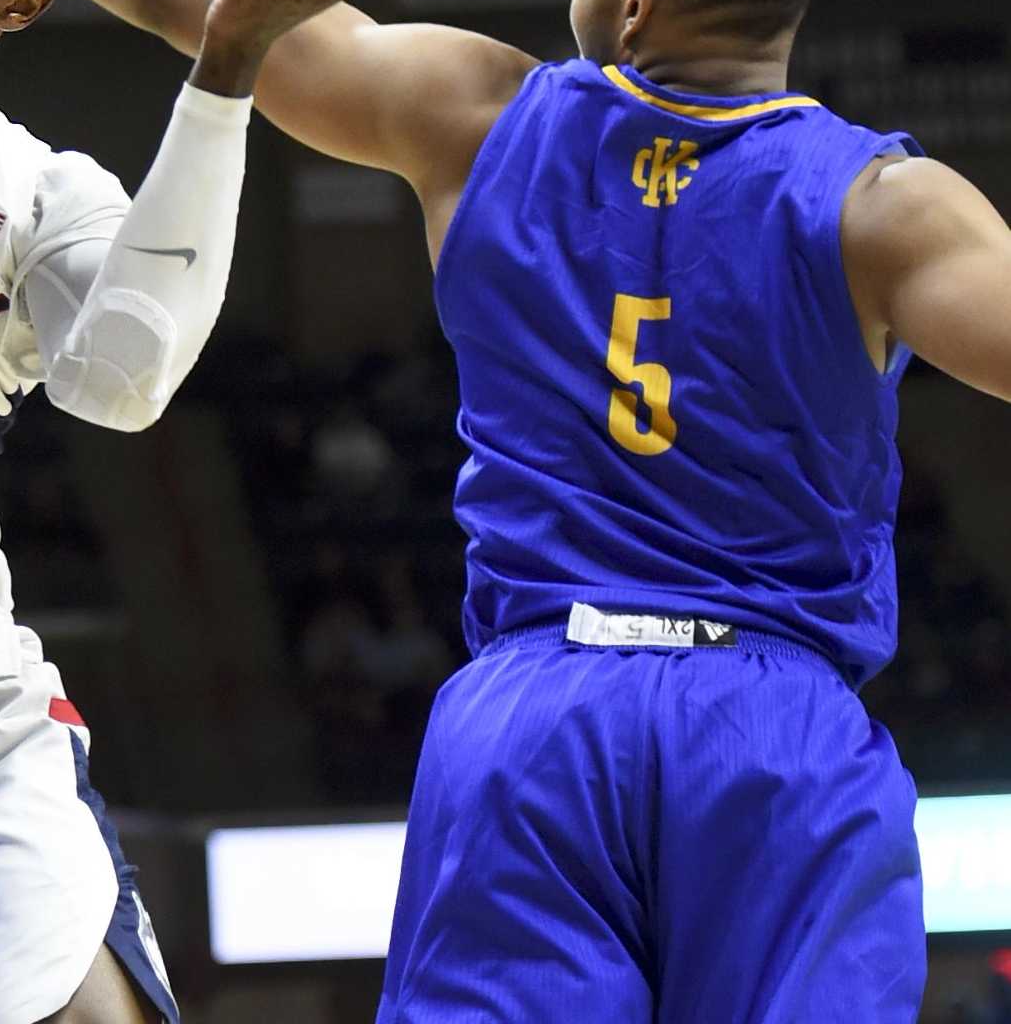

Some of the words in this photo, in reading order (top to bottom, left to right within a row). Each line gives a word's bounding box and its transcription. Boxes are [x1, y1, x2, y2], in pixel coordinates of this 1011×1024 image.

[607, 293, 677, 456] 5
[625, 623, 643, 640] 5
[657, 617, 692, 636] 2XL
